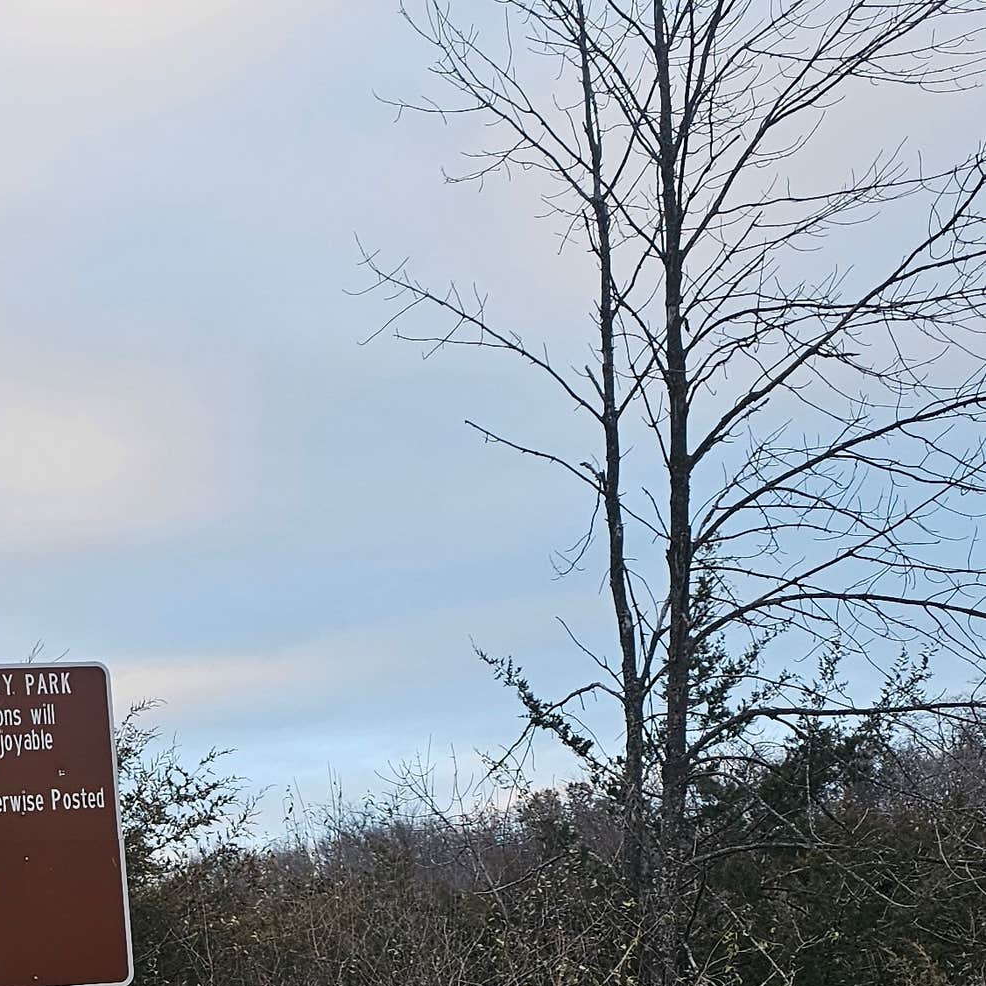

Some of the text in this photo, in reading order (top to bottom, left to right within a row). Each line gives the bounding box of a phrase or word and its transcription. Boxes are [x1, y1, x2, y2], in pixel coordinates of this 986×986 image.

[25, 672, 72, 695] PARK
[31, 703, 56, 726] will
[51, 787, 105, 811] Posted
